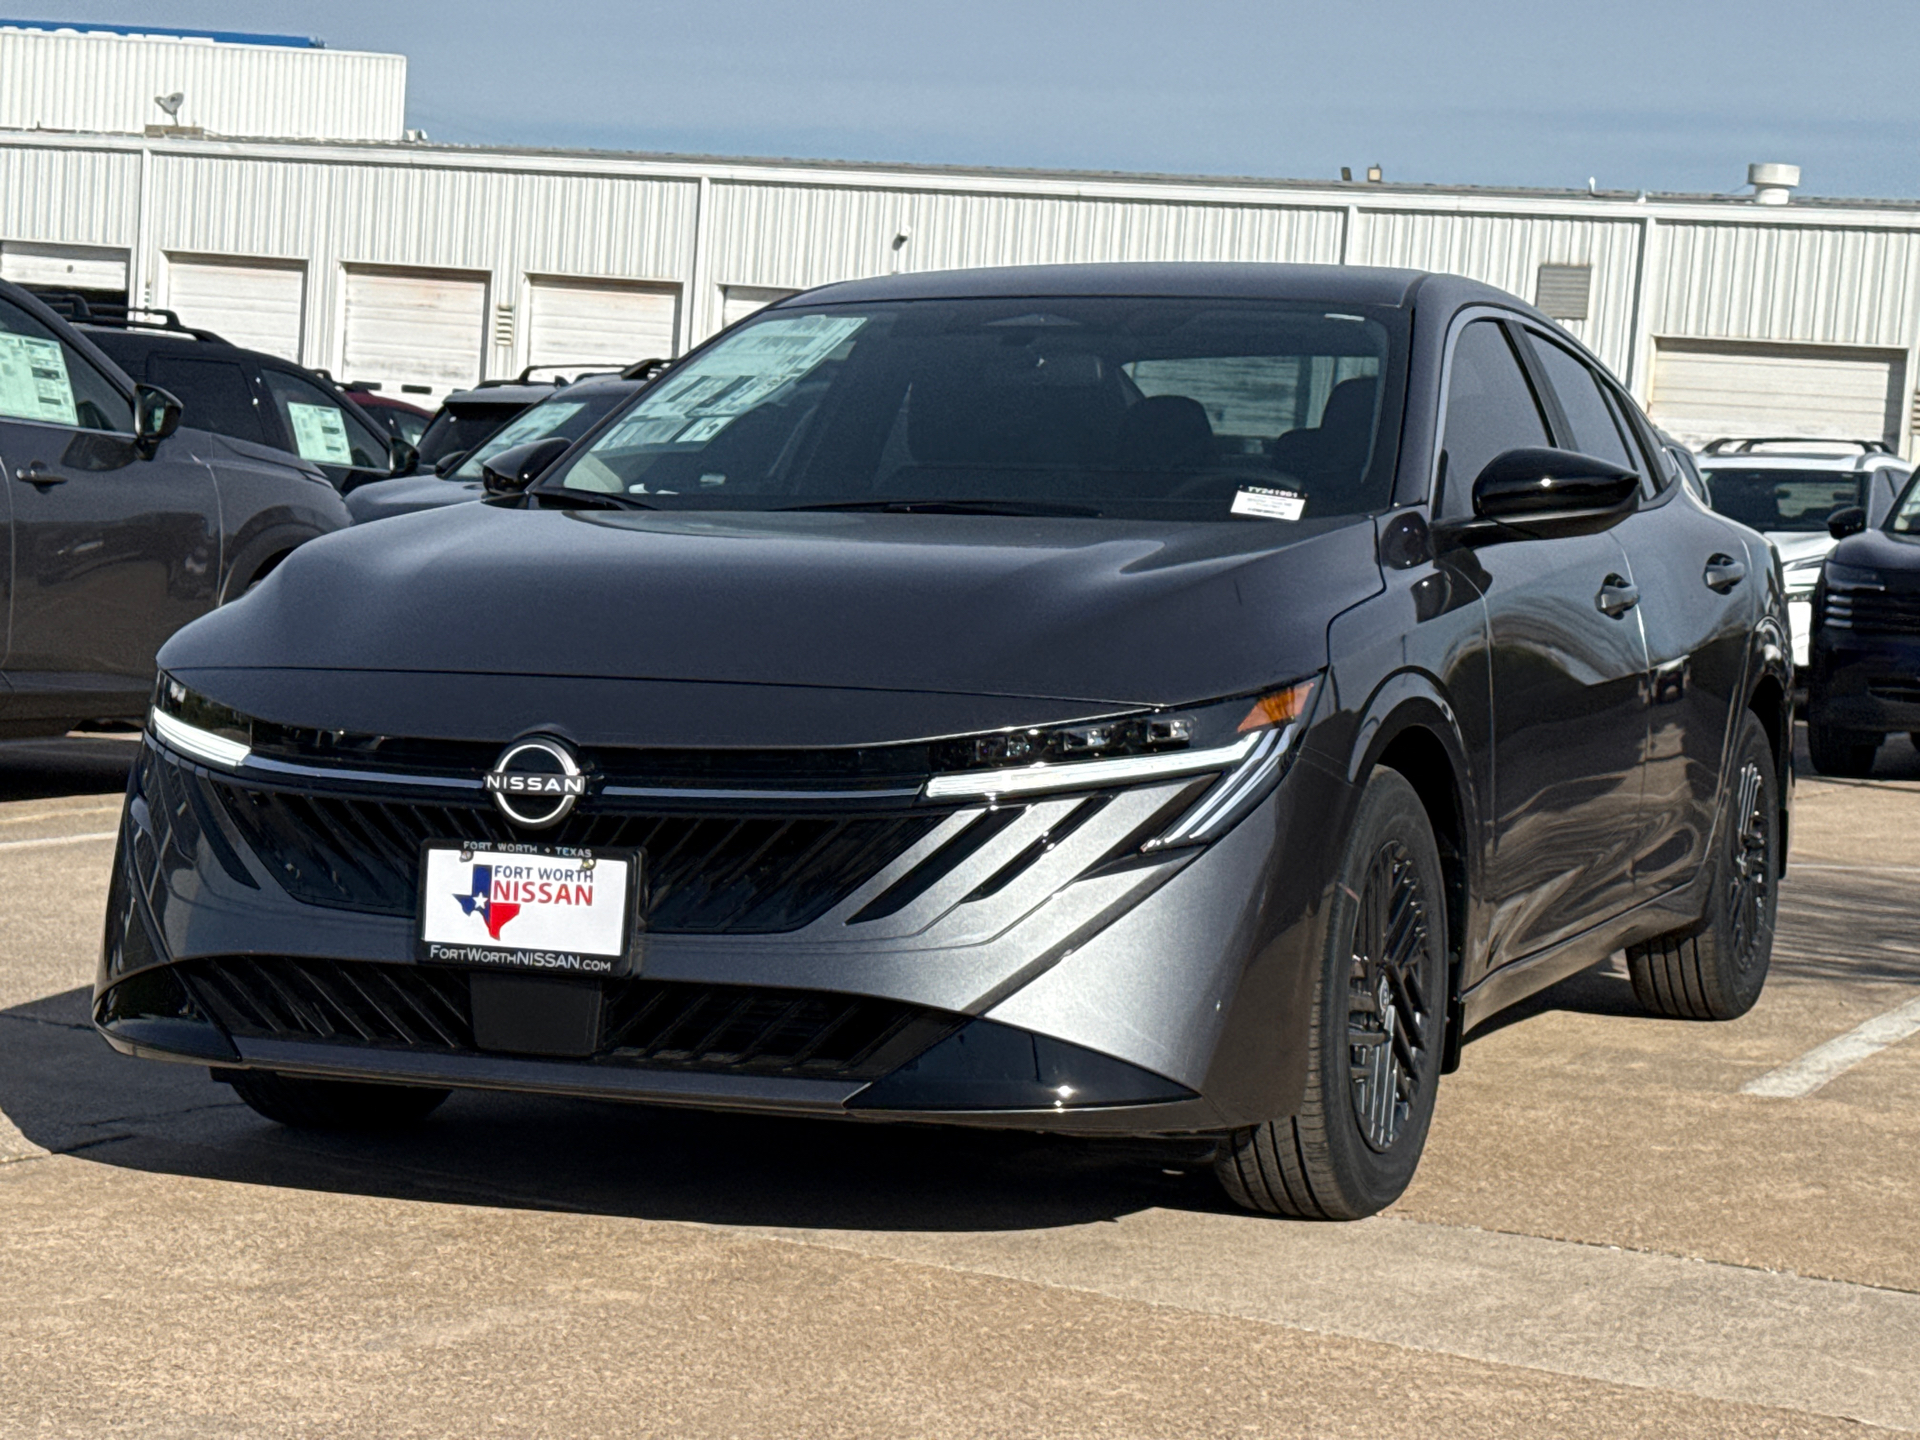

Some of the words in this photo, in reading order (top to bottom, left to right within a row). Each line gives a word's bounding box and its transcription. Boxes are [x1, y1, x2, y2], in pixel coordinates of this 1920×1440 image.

[486, 775, 582, 792] NISSAN
[463, 841, 492, 851] FORT
[497, 843, 538, 854] WORTH
[555, 846, 592, 858] TEXAS
[494, 865, 533, 880] FORT
[538, 867, 594, 884] WORTH
[493, 880, 593, 907] NISSAN
